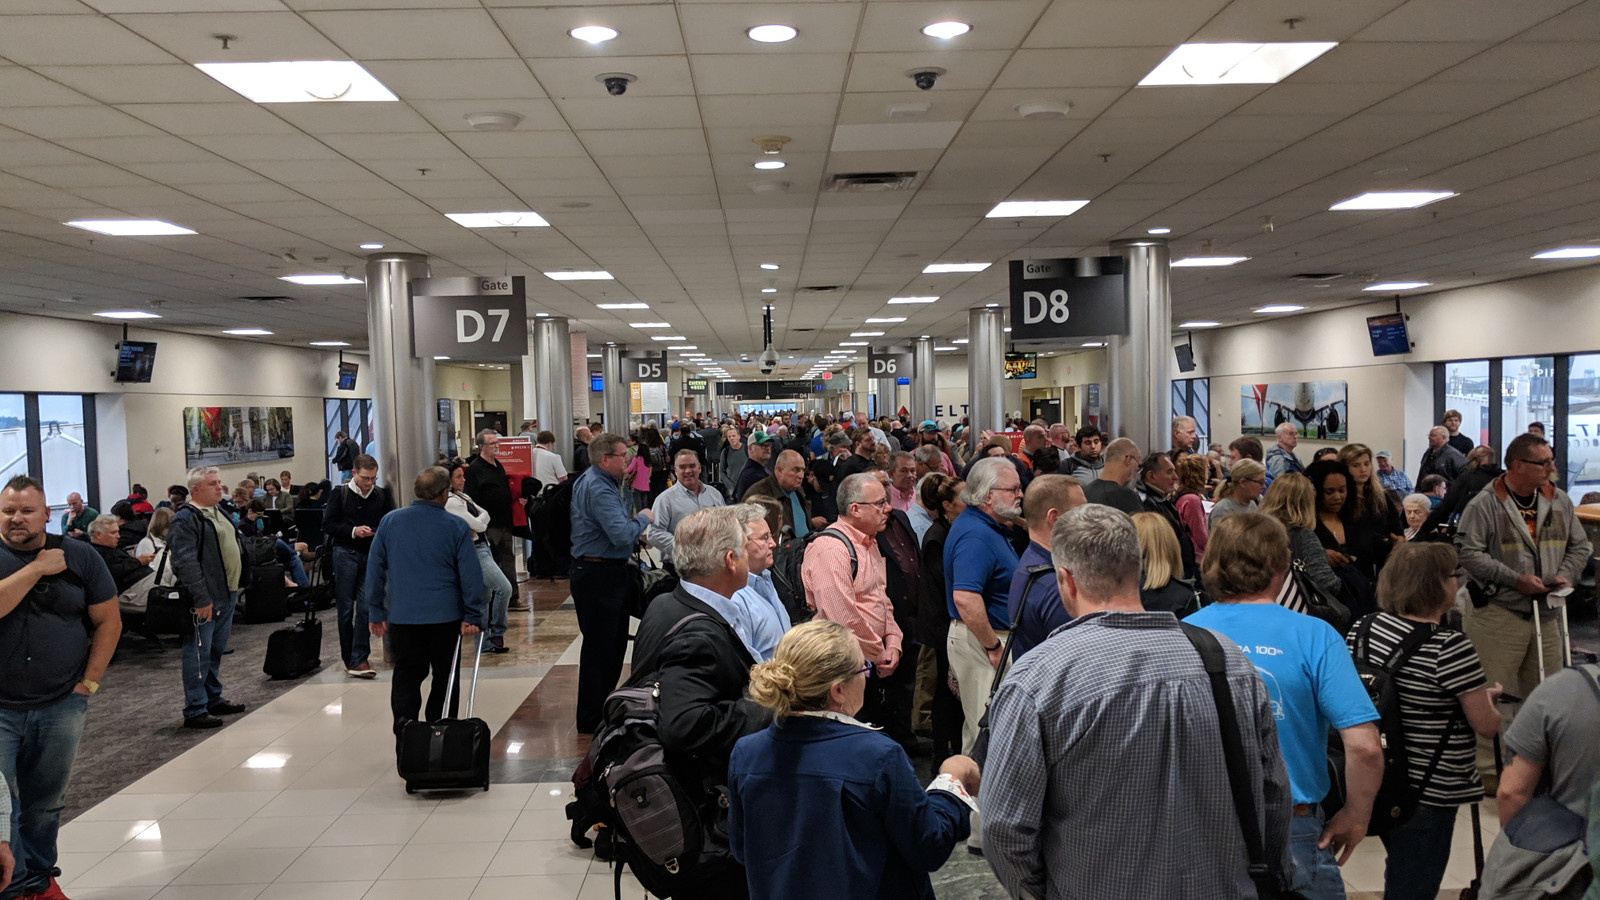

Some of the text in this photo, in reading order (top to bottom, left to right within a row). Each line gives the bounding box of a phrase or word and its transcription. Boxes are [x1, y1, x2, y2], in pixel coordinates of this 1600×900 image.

[1026, 264, 1052, 274] Gate
[481, 280, 508, 291] Gate
[1023, 289, 1070, 324] D8
[456, 309, 510, 343] D7
[639, 364, 661, 378] D5
[873, 358, 897, 374] D6
